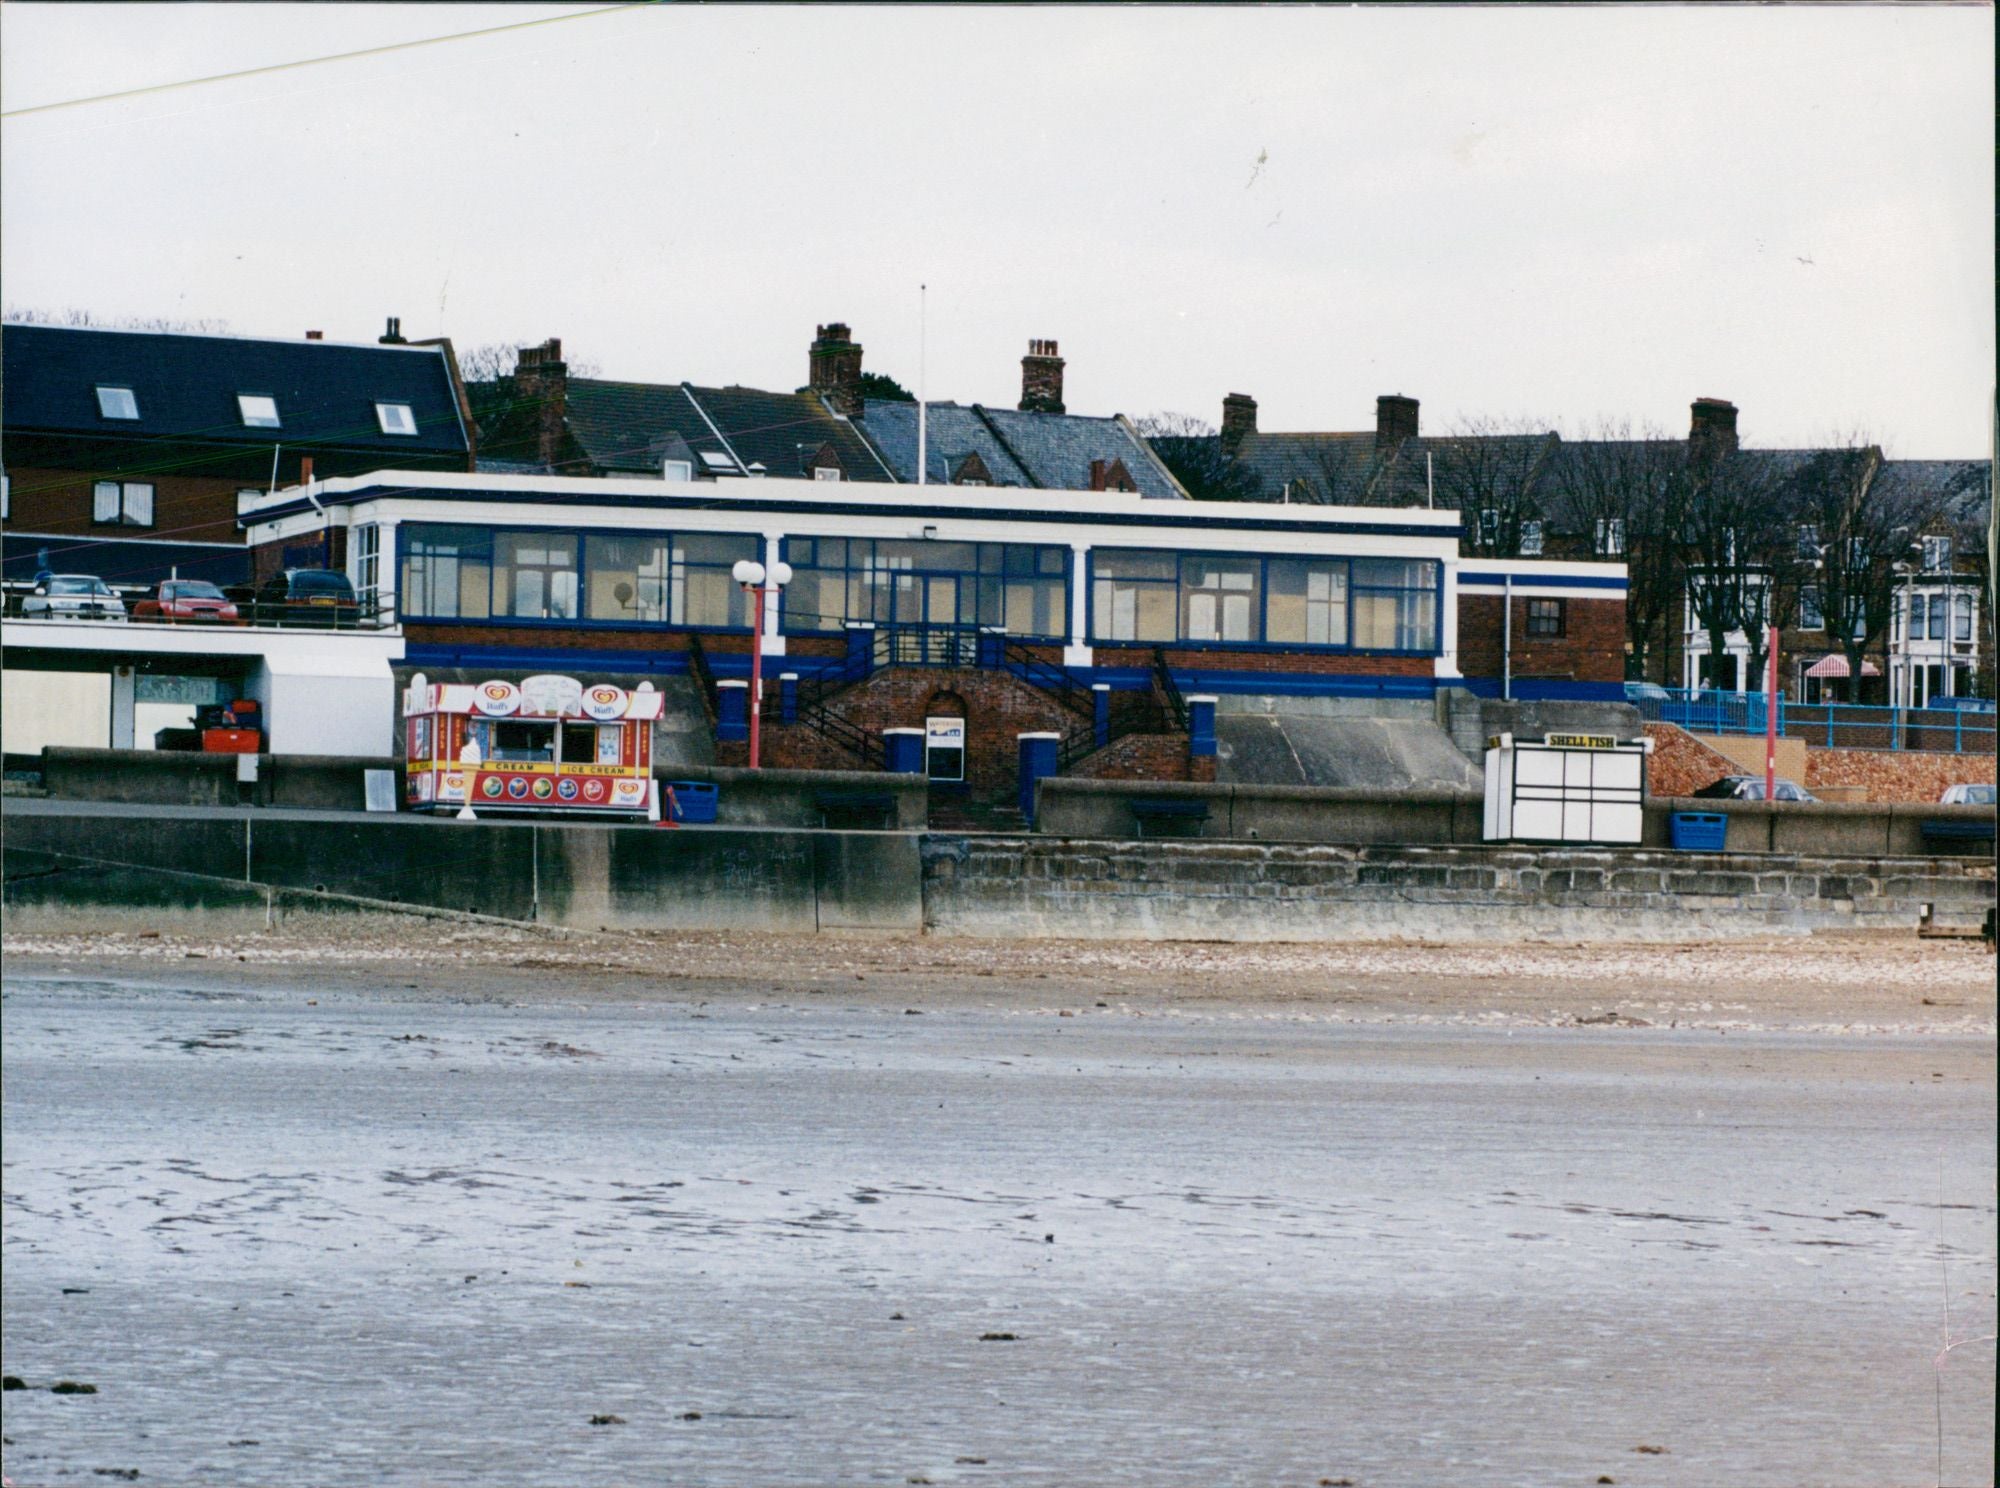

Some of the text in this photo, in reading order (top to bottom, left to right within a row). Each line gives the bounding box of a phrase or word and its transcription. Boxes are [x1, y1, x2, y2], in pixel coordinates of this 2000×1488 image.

[1550, 735, 1614, 748] SHELL FISH
[496, 762, 534, 770] CREAM
[590, 767, 625, 775] CREAM
